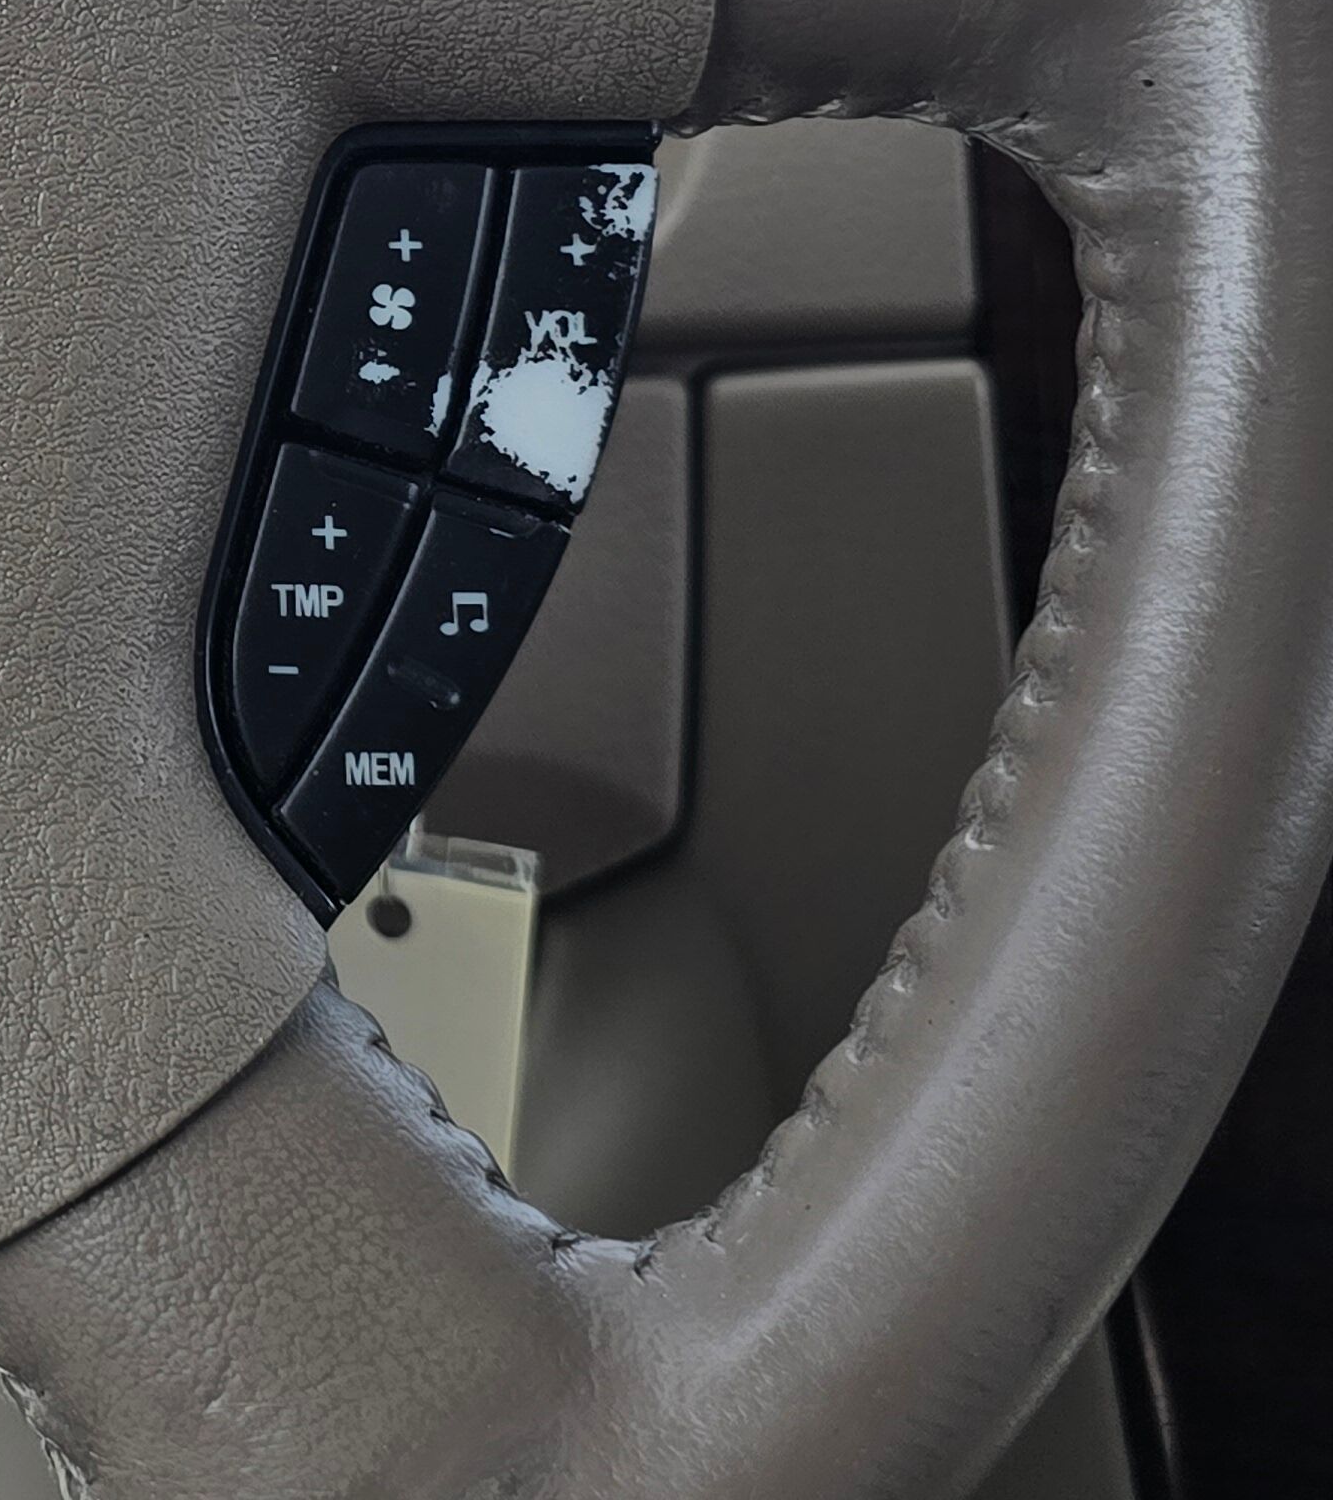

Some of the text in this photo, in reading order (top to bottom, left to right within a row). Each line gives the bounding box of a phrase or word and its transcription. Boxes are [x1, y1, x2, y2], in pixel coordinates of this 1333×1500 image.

[524, 309, 598, 347] VOL
[271, 583, 345, 619] TMP
[344, 751, 416, 787] MEM
